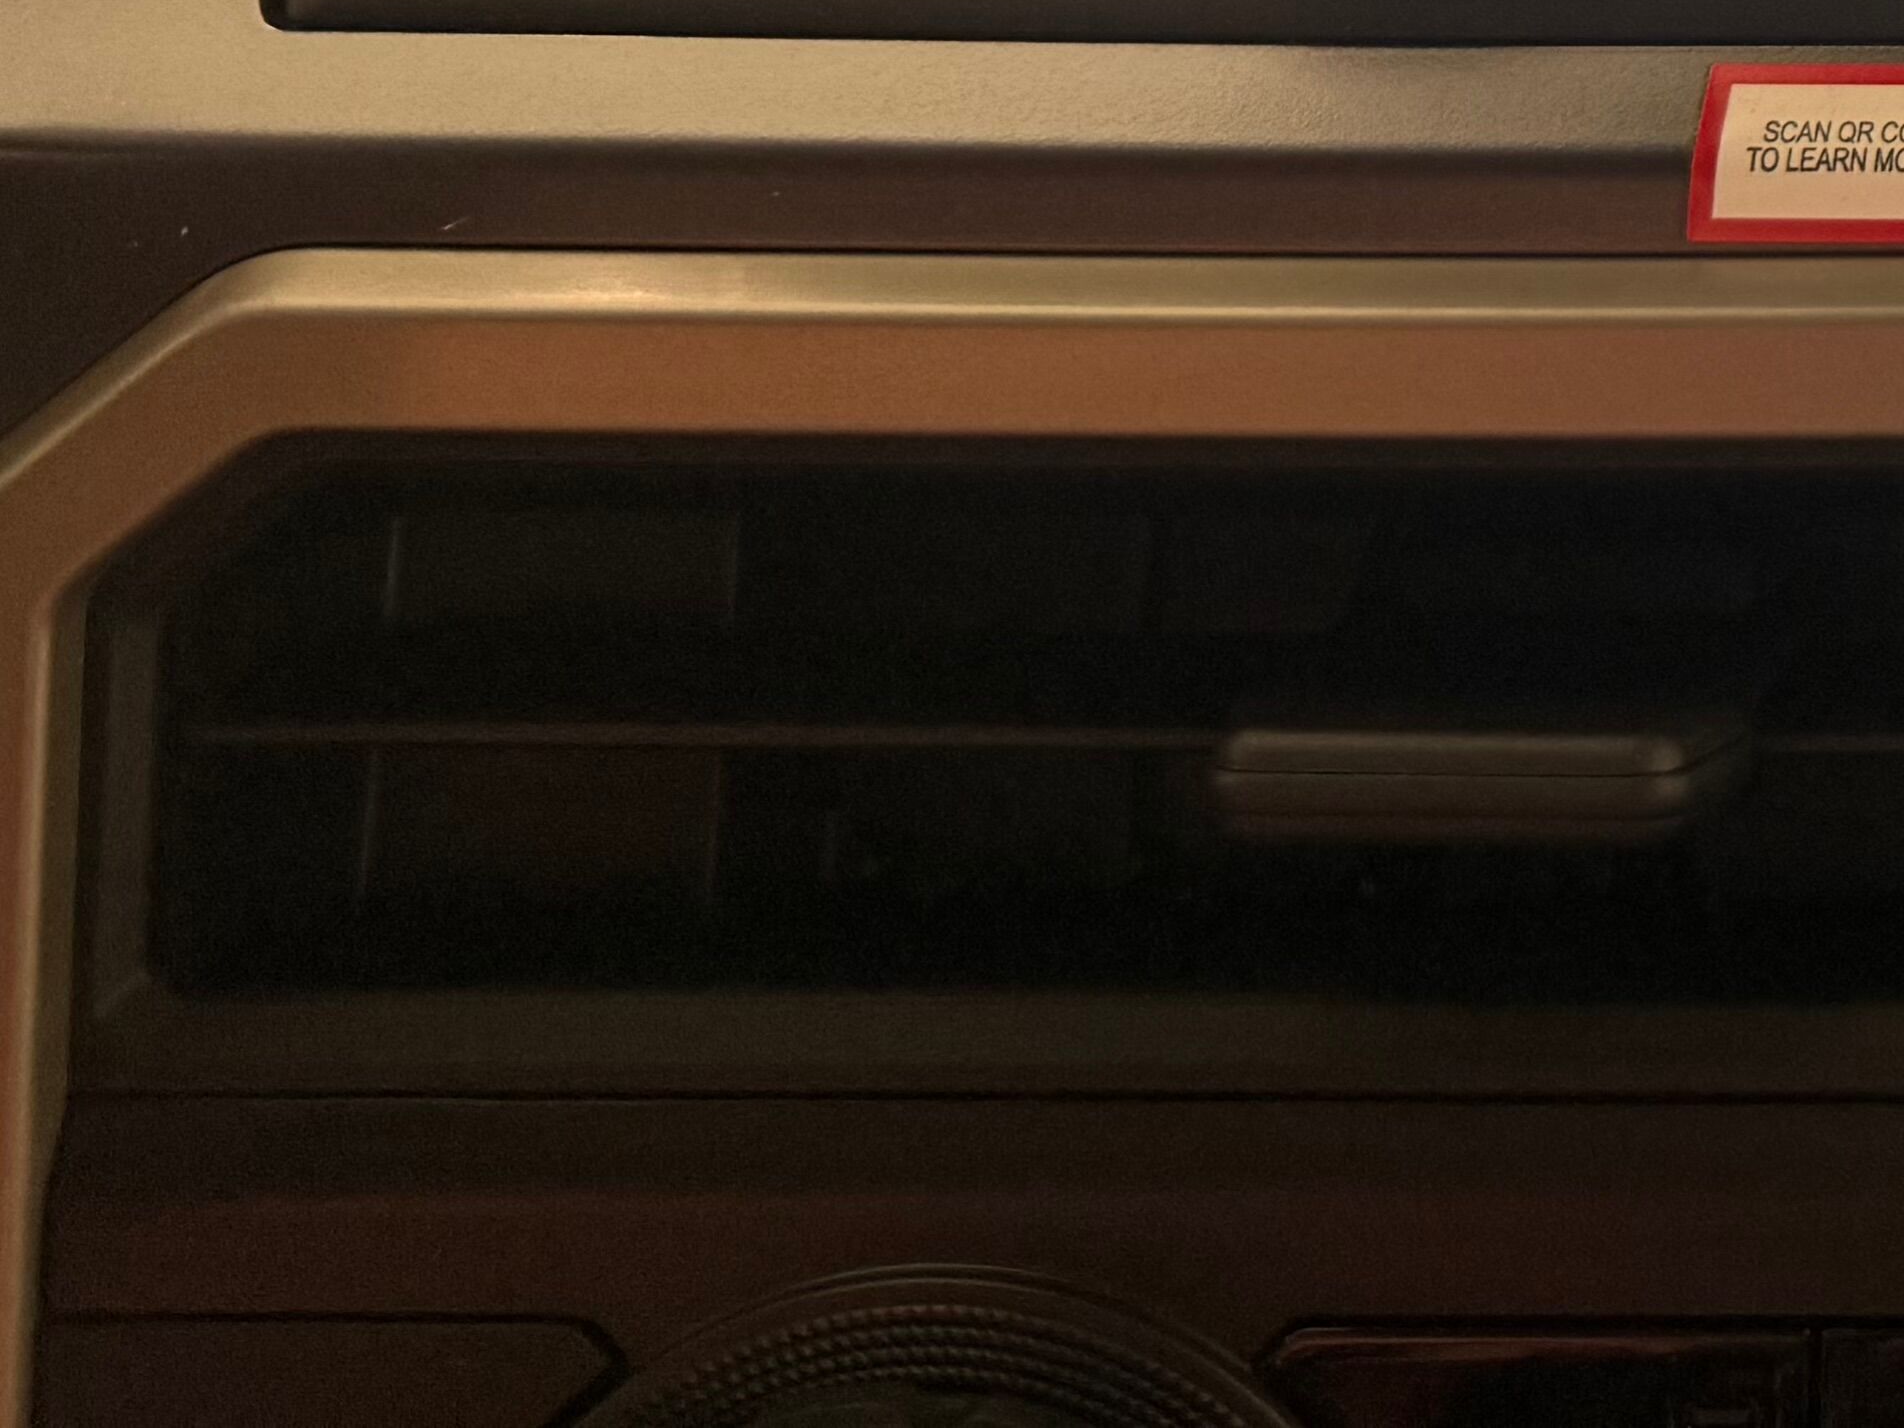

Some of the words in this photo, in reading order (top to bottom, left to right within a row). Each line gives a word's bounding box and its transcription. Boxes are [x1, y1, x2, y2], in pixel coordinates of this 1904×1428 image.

[1762, 120, 1831, 143] SCAN
[1838, 120, 1874, 145] QR
[1747, 147, 1779, 172] TO
[1785, 147, 1867, 172] LEARN
